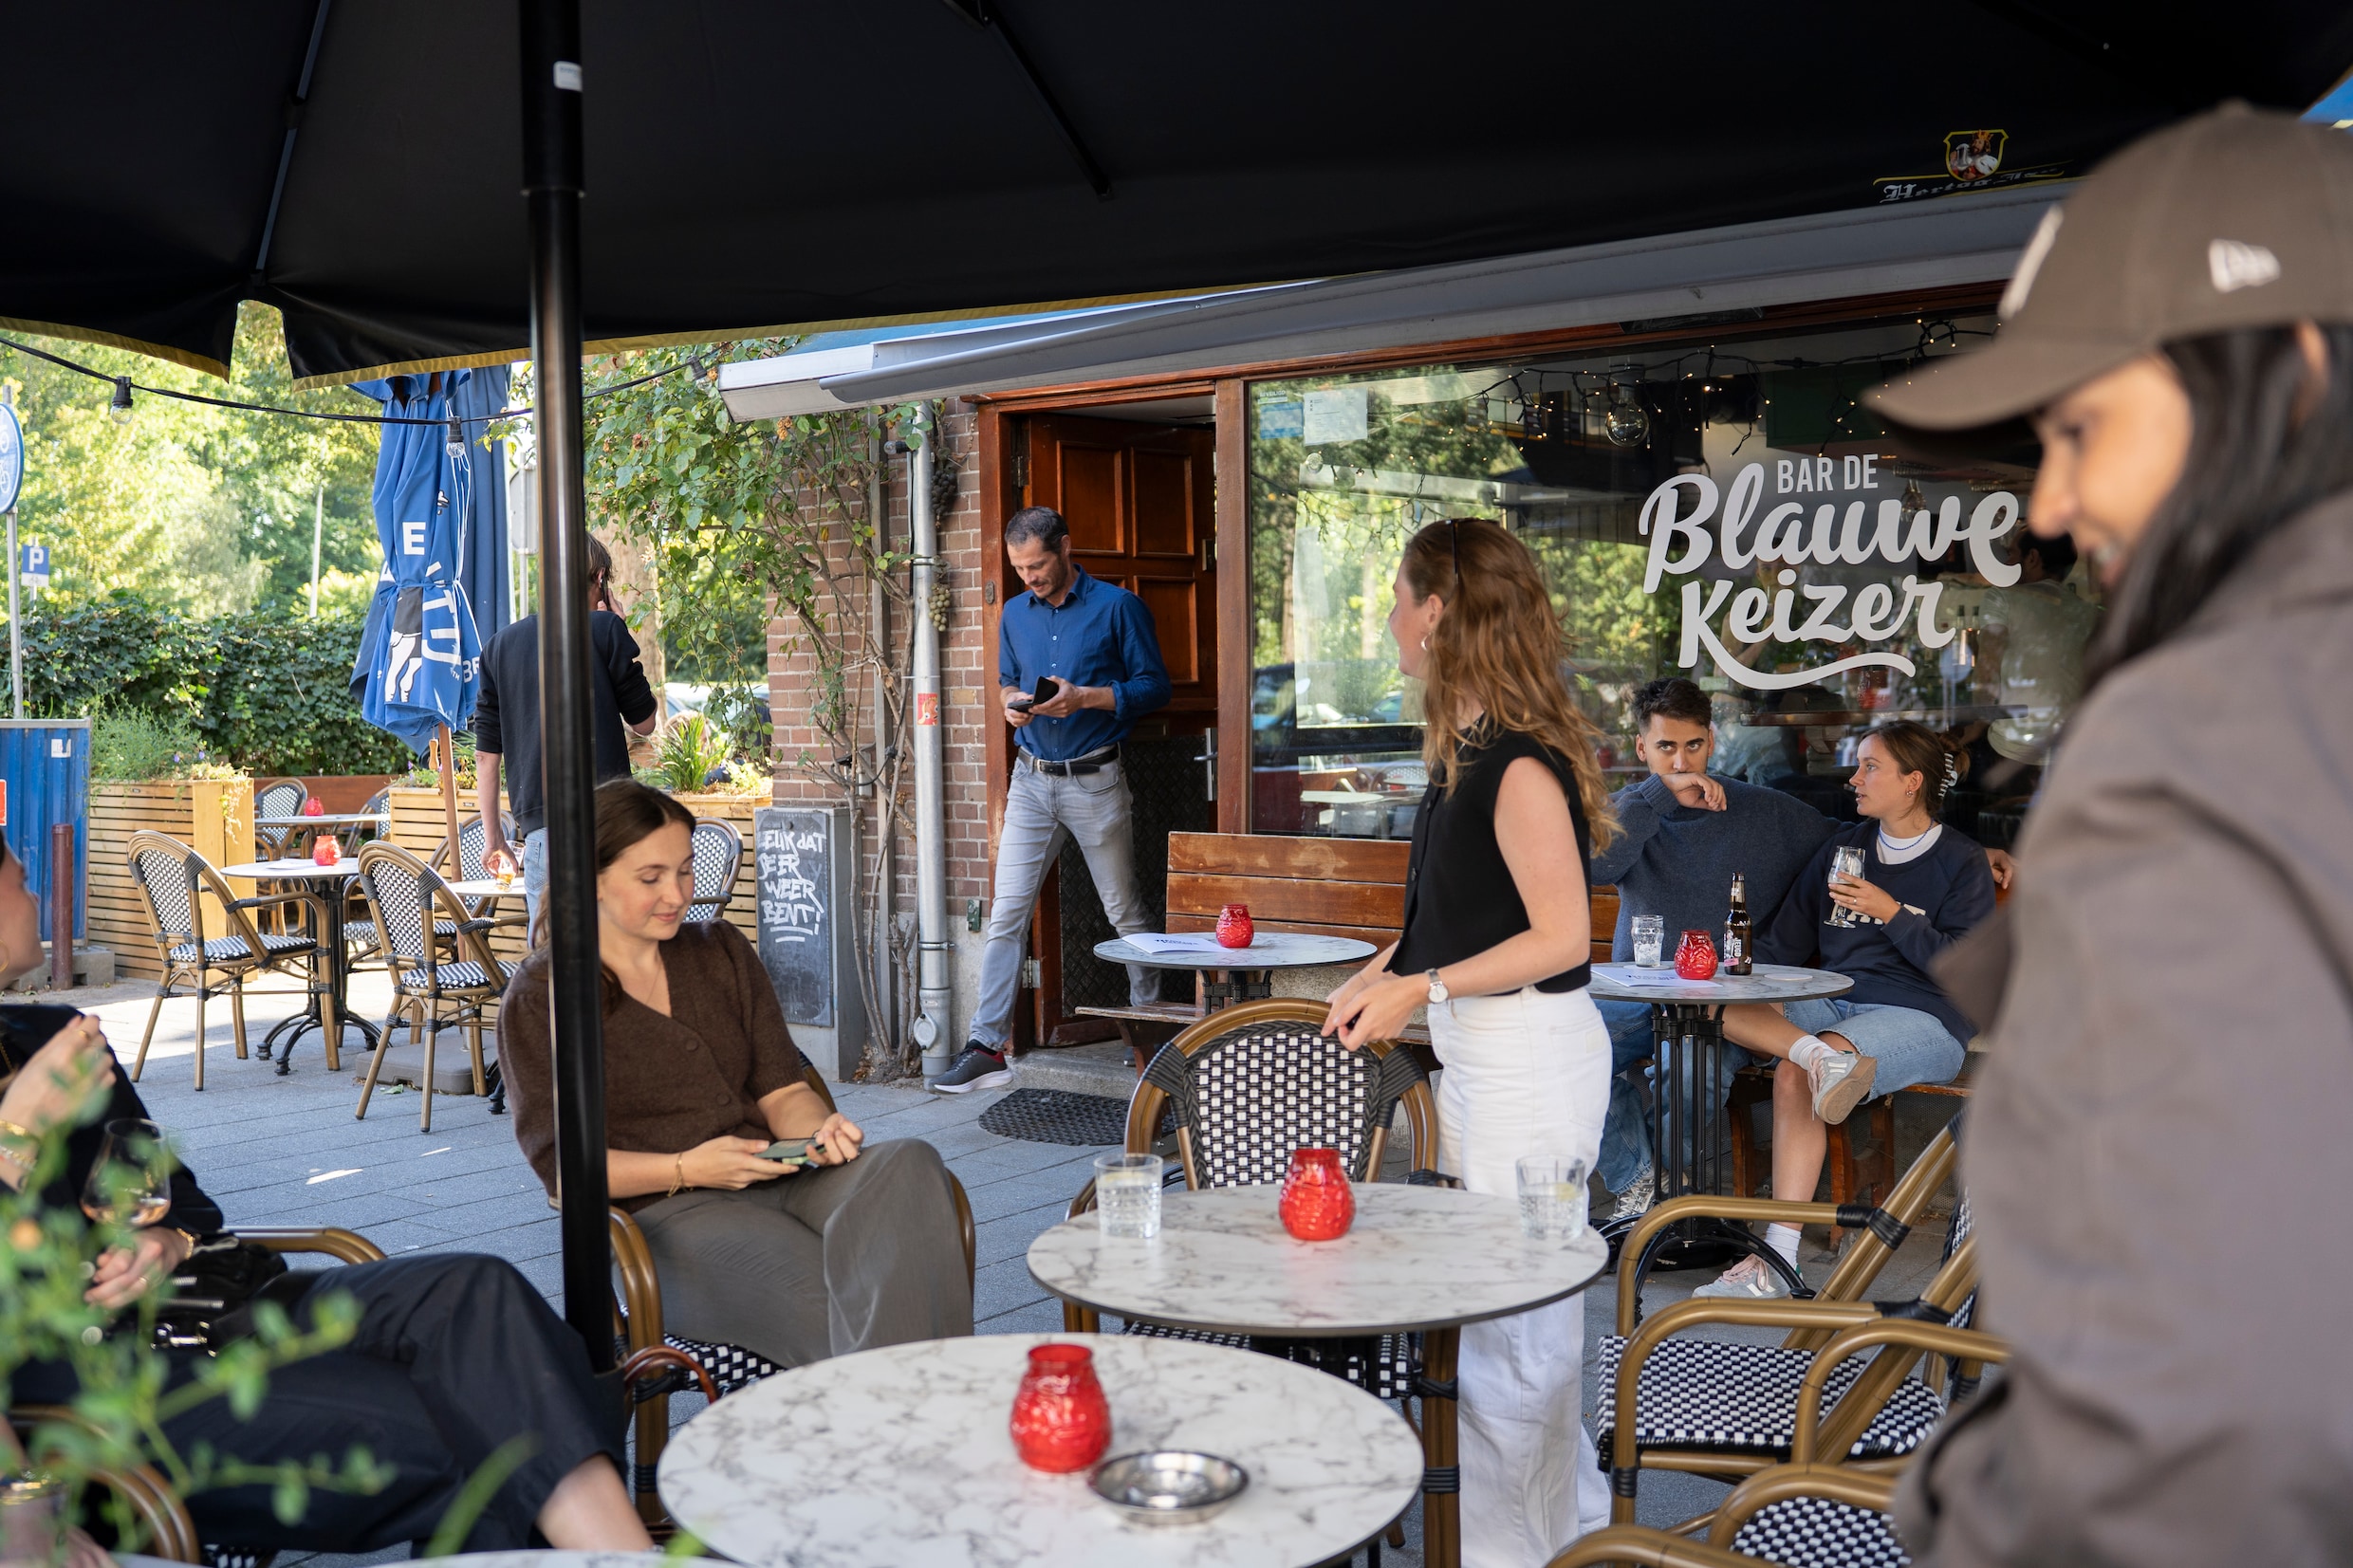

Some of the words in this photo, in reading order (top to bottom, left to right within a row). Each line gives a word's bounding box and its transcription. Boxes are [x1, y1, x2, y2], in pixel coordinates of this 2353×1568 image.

[1777, 457, 1833, 493] BAR
[1843, 453, 1879, 490] DE
[1639, 462, 2022, 594] Blauwe
[29, 547, 44, 571] P
[1677, 568, 1956, 691] Keizer
[758, 852, 777, 879] JE
[777, 853, 803, 880] ER
[764, 877, 824, 913] WEER
